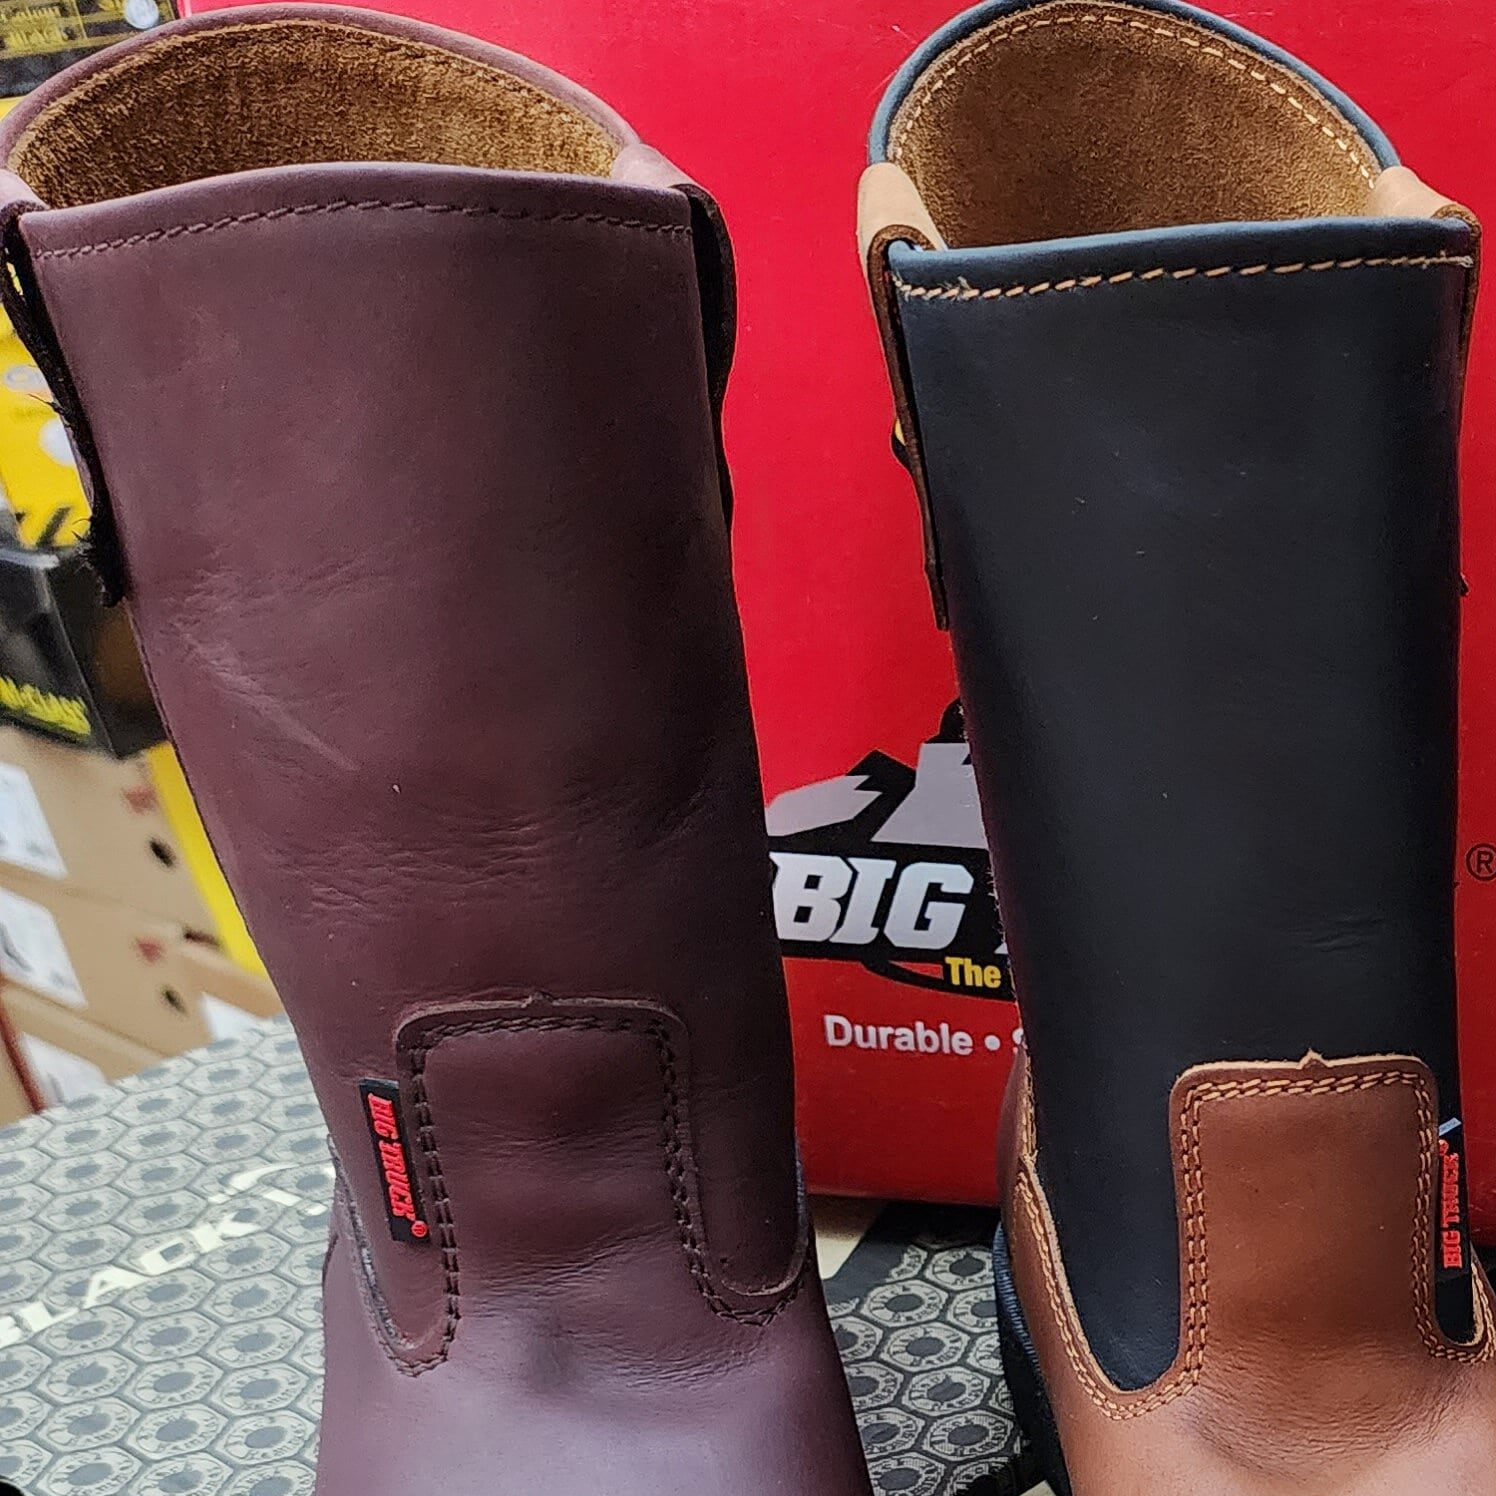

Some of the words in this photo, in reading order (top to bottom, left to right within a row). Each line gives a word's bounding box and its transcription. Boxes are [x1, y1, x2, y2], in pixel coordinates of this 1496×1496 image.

[769, 851, 974, 950] BIG
[945, 956, 1002, 989] The
[823, 1014, 974, 1056] Durable
[367, 1092, 399, 1140] BIG
[378, 1139, 417, 1222] TRUCK
[1441, 1152, 1461, 1228] TRUCK
[1442, 1229, 1463, 1269] BIG
